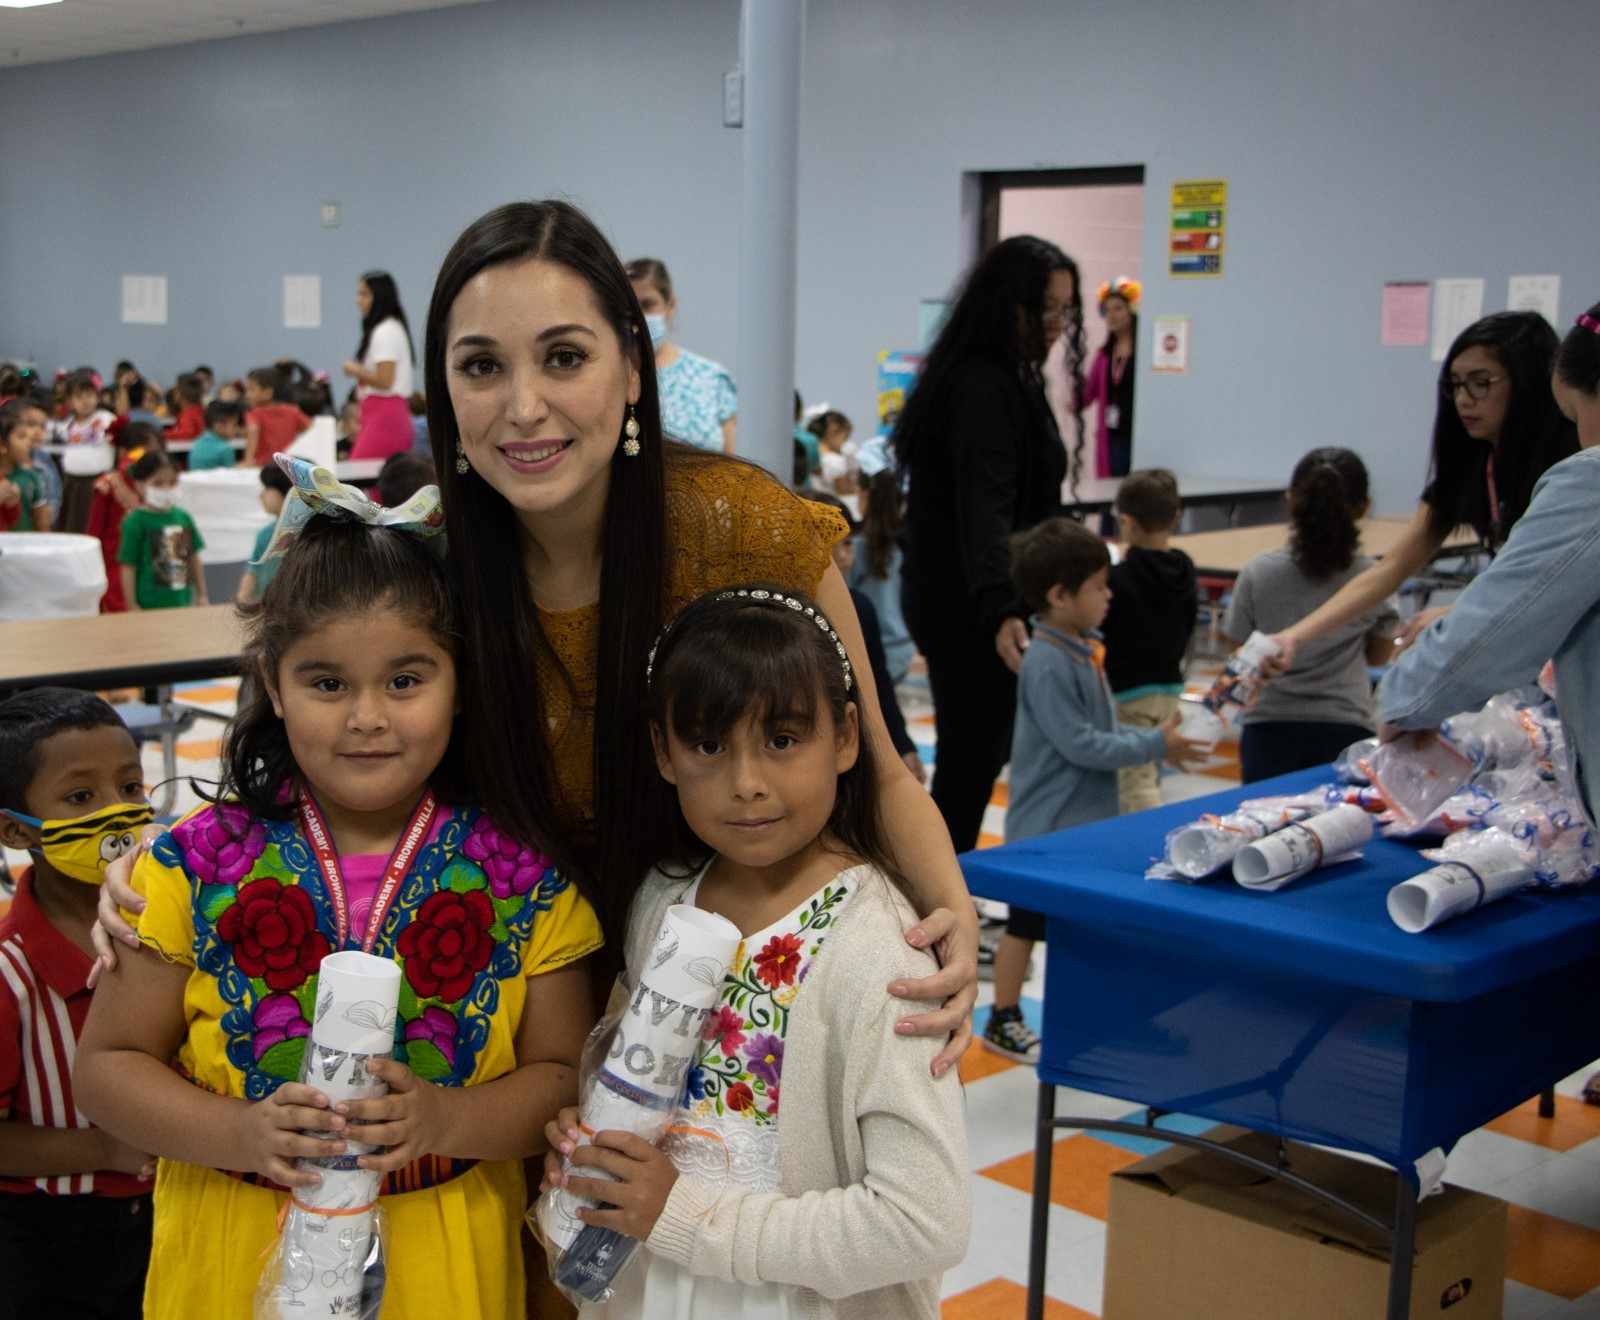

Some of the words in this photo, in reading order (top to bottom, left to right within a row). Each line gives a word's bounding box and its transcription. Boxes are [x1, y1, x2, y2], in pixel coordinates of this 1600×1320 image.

[302, 804, 329, 853] ACADEMY
[370, 876, 397, 932] ACADEMY
[394, 798, 435, 870] BROWNSVILLE
